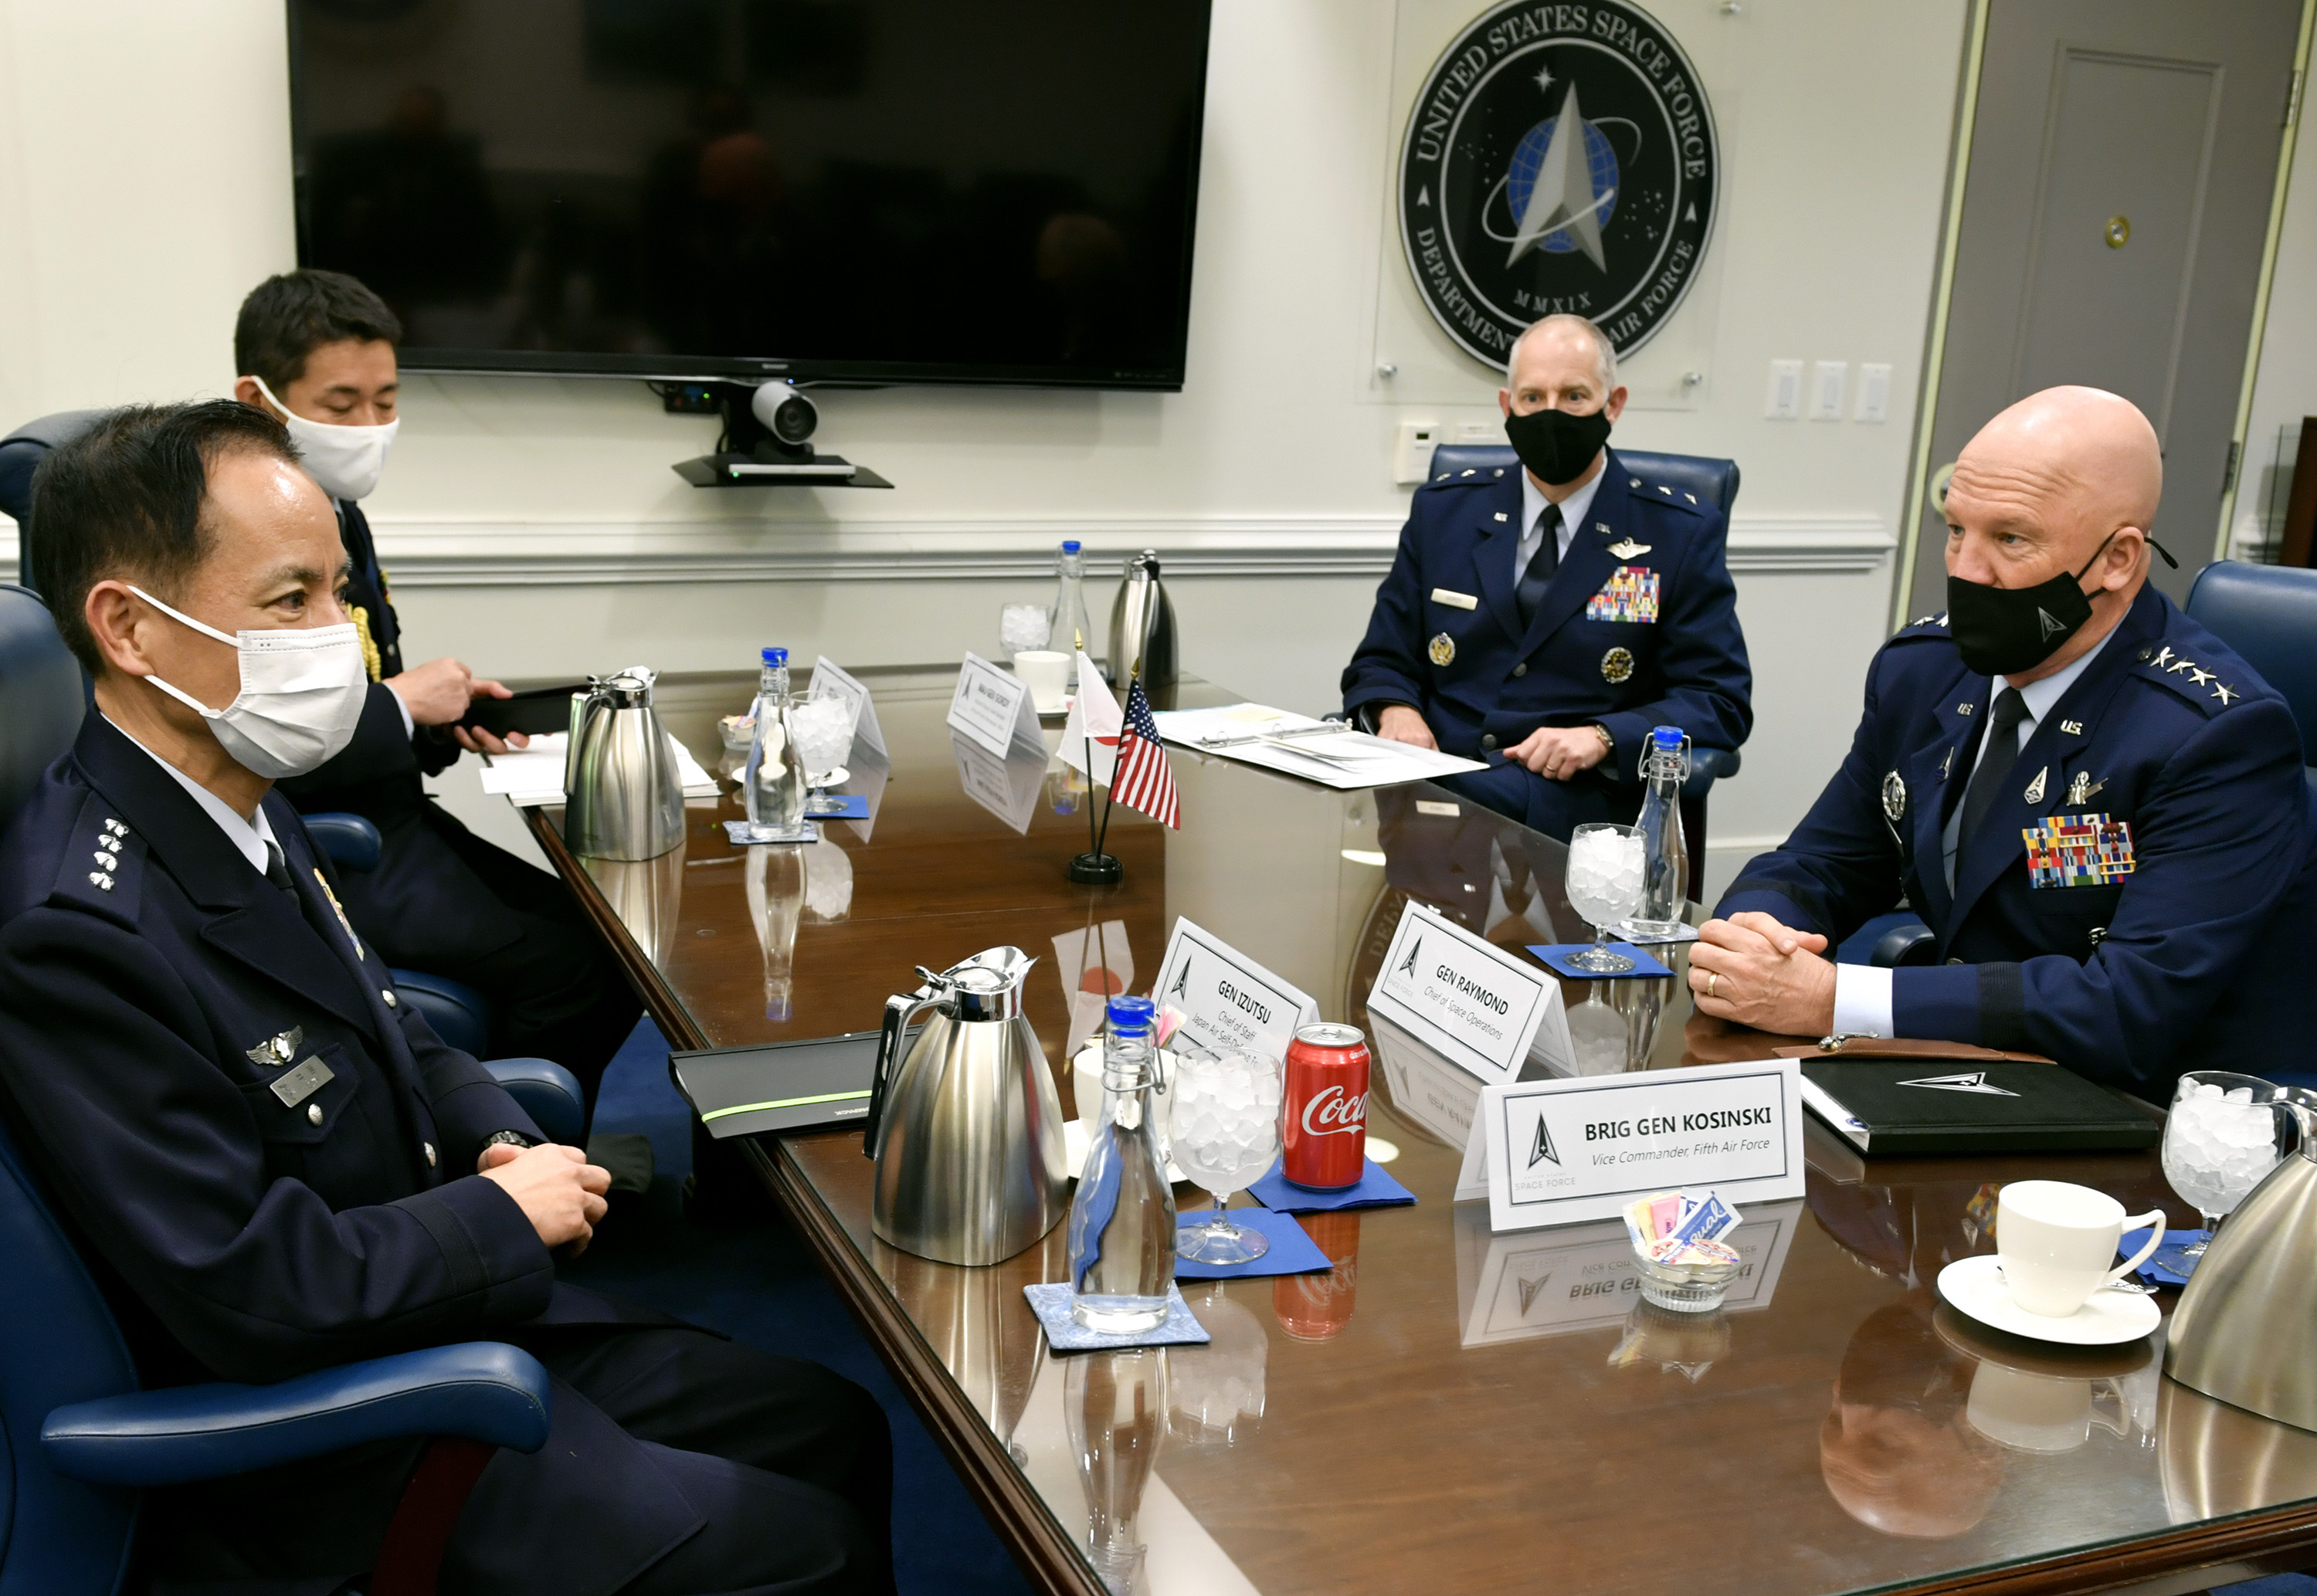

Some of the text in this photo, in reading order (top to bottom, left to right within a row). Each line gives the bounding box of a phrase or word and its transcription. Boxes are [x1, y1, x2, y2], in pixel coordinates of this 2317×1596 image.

[1416, 5, 1706, 180] UNITED STATES SPACE FORCE
[1513, 289, 1592, 313] MMXIX
[1609, 311, 1643, 346] AIR
[1640, 239, 1694, 318] FORCE
[1218, 980, 1271, 1024] GEN IZUTSU
[1437, 965, 1458, 985] GEN
[1456, 976, 1508, 1015] RAYMOND
[1192, 1013, 1210, 1031] Japan
[1209, 1024, 1220, 1036] Air
[1218, 1011, 1257, 1042] Chief of Staff
[1424, 986, 1503, 1040] Chief of Space Operations
[1586, 1106, 1772, 1140] BRIG GEN KOSINSKI
[1592, 1138, 1770, 1165] Vice Commander, Fifth Air Force
[1515, 1177, 1576, 1191] SPACE FORCE
